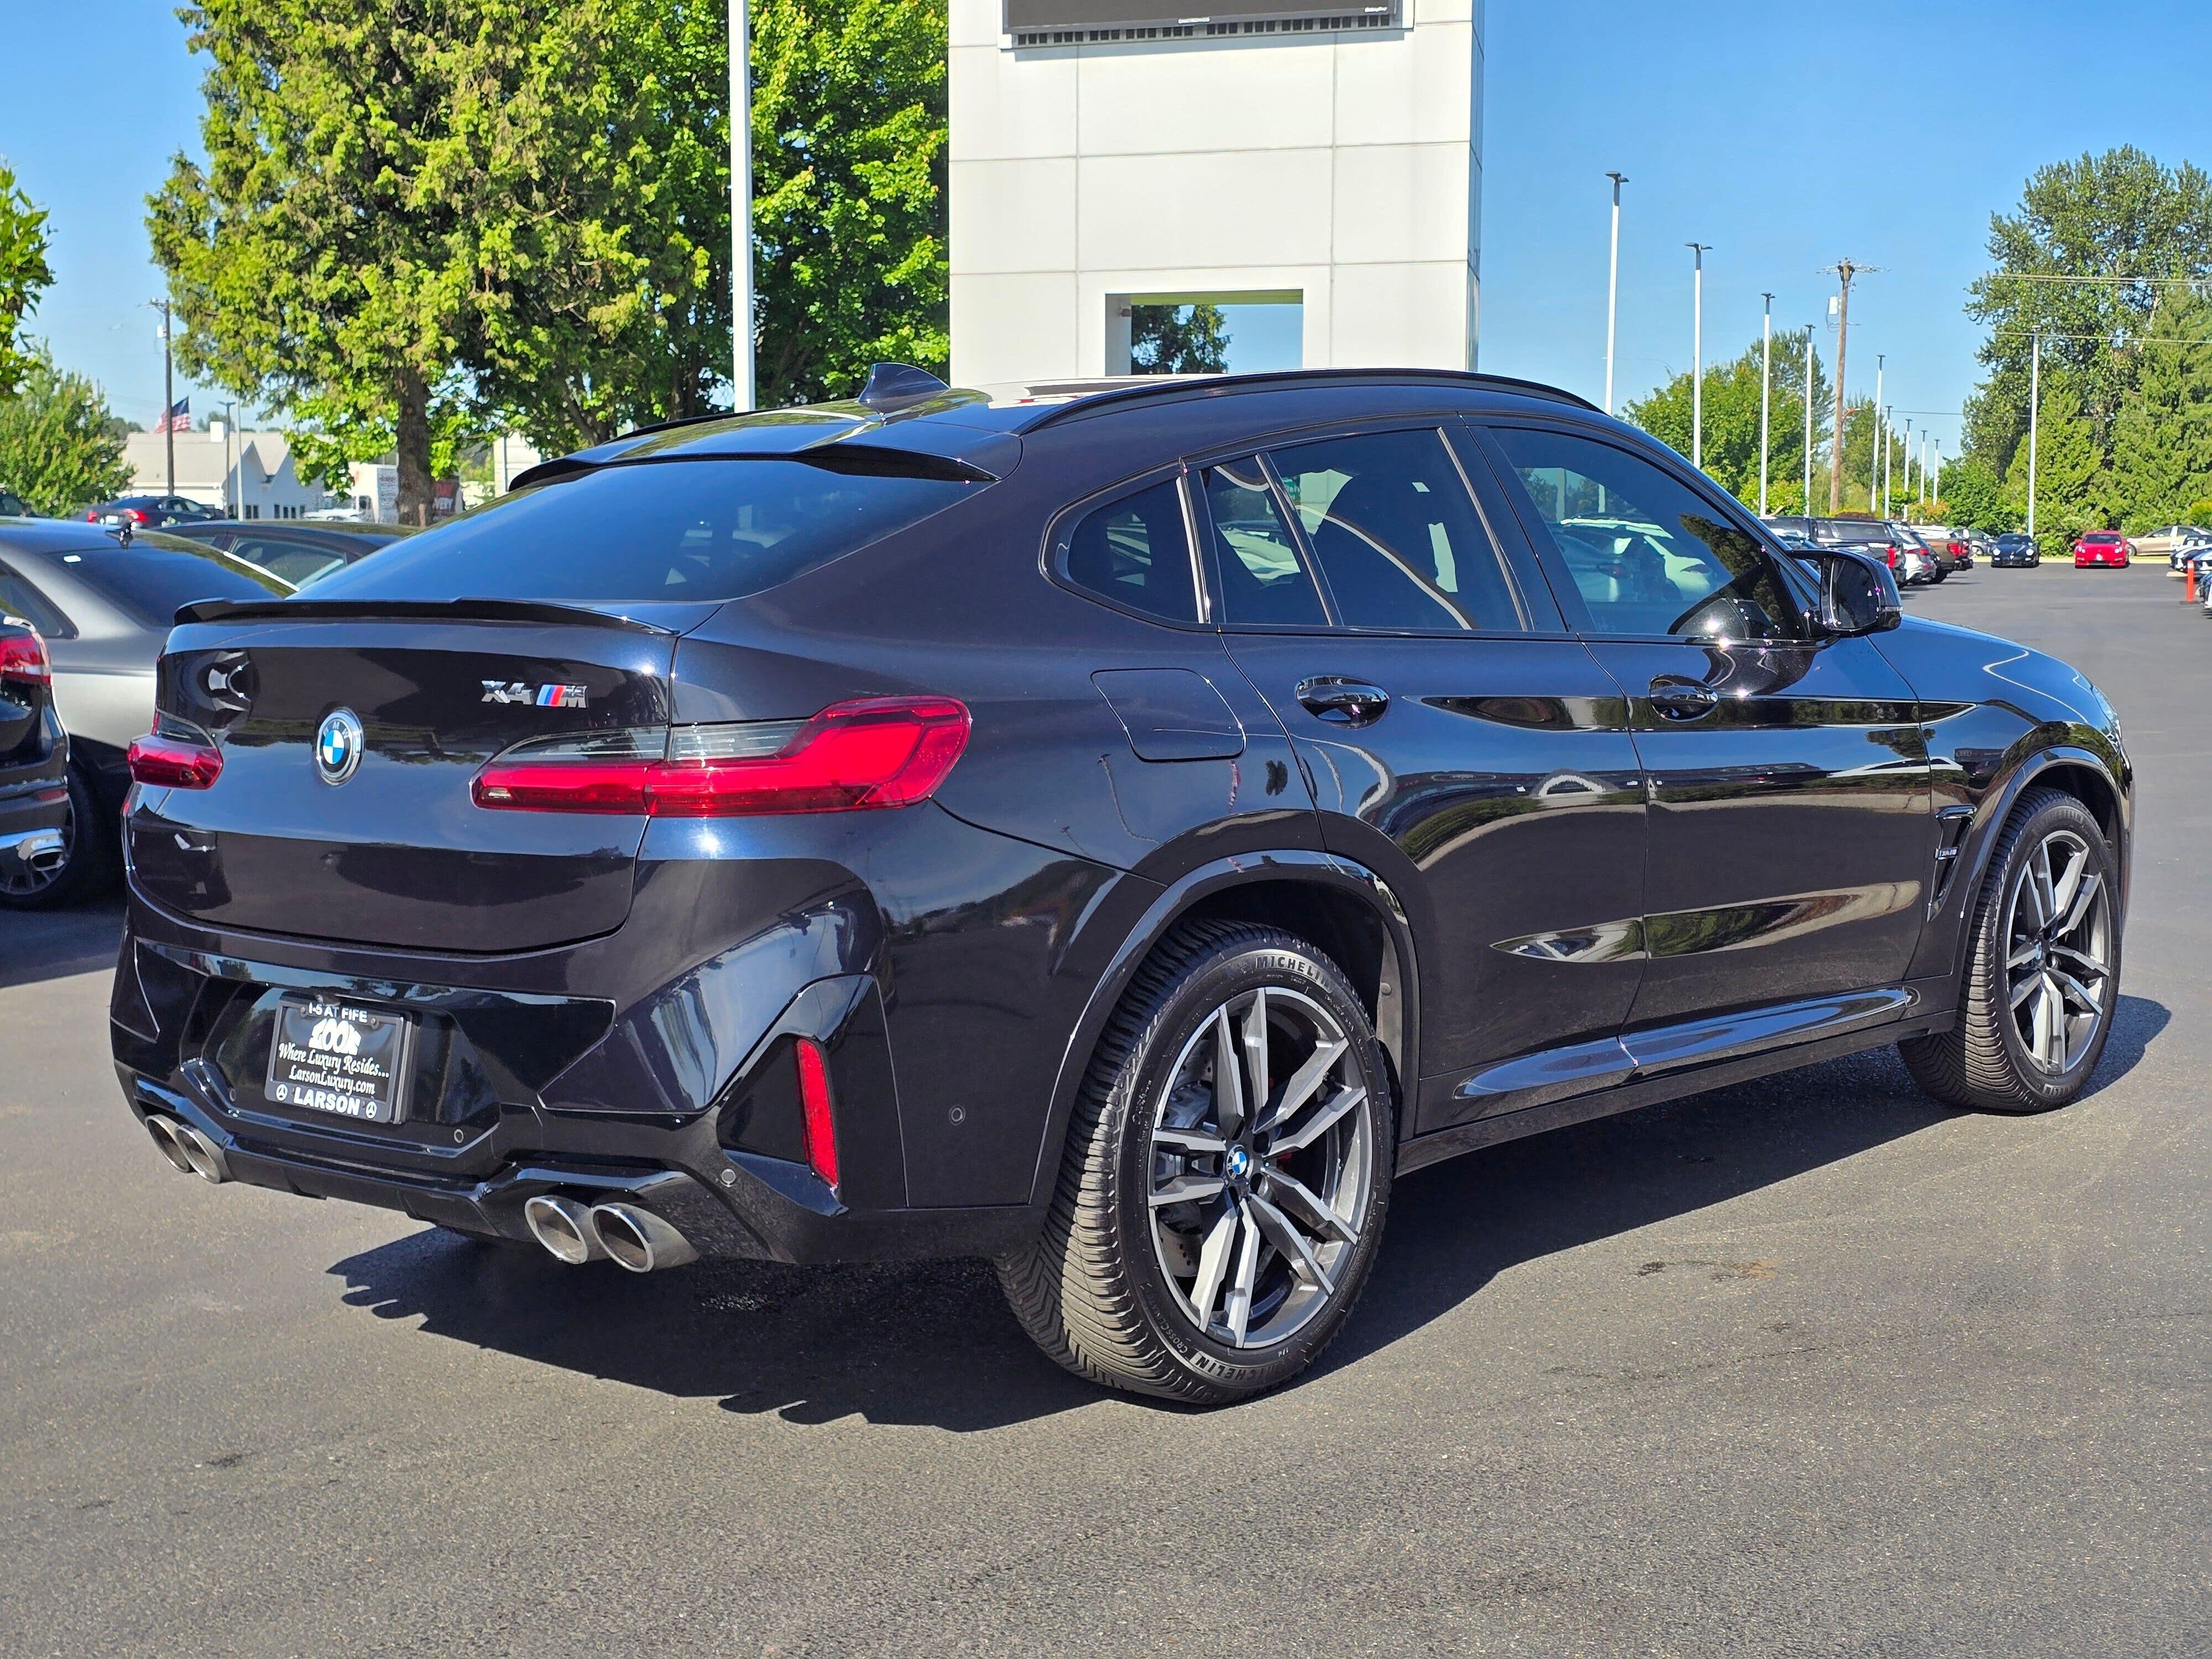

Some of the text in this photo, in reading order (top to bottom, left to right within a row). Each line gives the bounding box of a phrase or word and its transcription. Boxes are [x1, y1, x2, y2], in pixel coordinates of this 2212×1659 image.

[481, 680, 534, 706] X4
[1256, 956, 1333, 993] MICHELIN
[324, 1006, 339, 1018] AT
[341, 1008, 368, 1023] FIFE
[279, 1042, 389, 1078] Where Luxury Resides...
[289, 1065, 375, 1096] LarsonLuxury.com
[293, 1087, 361, 1116] LARSON
